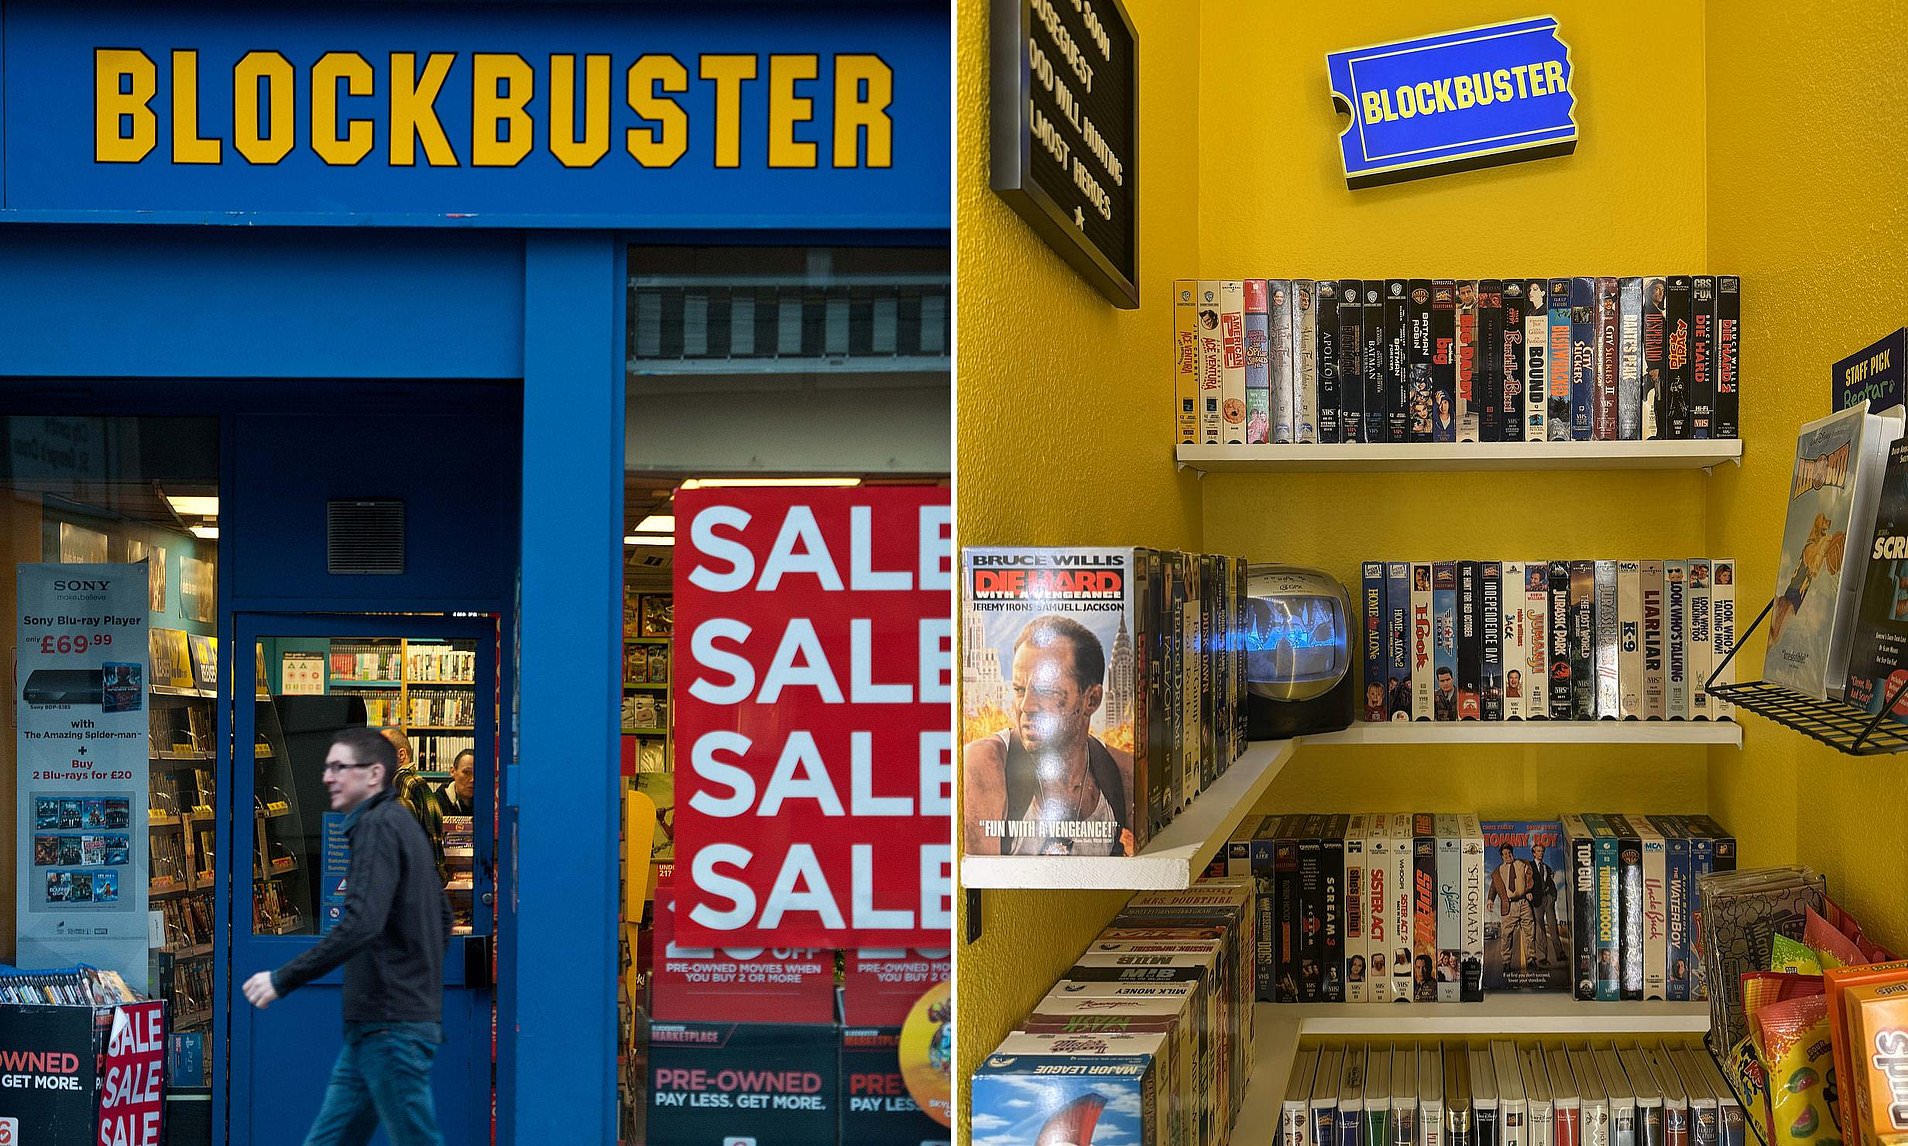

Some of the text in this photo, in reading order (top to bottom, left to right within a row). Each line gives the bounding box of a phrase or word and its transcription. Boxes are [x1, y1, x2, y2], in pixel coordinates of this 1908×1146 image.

[93, 47, 893, 169] BLOCKBUSTER
[1361, 60, 1566, 125] BLOCKBUSTER
[1055, 75, 1082, 134] WILL
[1083, 116, 1123, 187] HUNTING
[1693, 278, 1712, 289] CBS
[1693, 289, 1712, 299] FOX
[1180, 331, 1193, 374] ACE VENTURA
[1223, 314, 1235, 368] PIE
[1232, 315, 1243, 366] AMERICAN
[1411, 319, 1420, 349] ROBIN
[1432, 337, 1453, 366] big
[1623, 314, 1638, 380] DANTE'S PEAK
[1645, 313, 1664, 363] DESPERADO
[1695, 314, 1705, 383] DIE HARD
[1202, 337, 1217, 390] ACE VENTURA
[1323, 331, 1333, 392] APOLLO 13
[1460, 314, 1474, 402] BIG DADDY
[1529, 346, 1544, 403] BOUND
[1551, 325, 1569, 397] BUSHWHACKED
[1573, 340, 1584, 384] SLICKERS
[1582, 346, 1593, 370] CITY
[1605, 325, 1615, 395] CITY SLICKERS II
[1722, 319, 1732, 393] DIE HARD 2
[1846, 348, 1890, 387] STAFF PICK
[688, 506, 951, 592] SALE
[973, 555, 1124, 566] BRUCE WILLIS
[1873, 536, 1908, 560] SCR
[54, 580, 111, 591] SONY
[975, 570, 1122, 593] DIE HARD
[976, 591, 1121, 599] WITH A VENGEANCE
[1463, 566, 1473, 637] THE HUNT FOR RED OCTOBER
[23, 615, 141, 627] Sony Blu-ray Player
[973, 603, 1005, 612] JEREMY
[1006, 603, 1033, 612] IRONS
[1083, 603, 1125, 612] JACKSON
[1484, 582, 1498, 664] INDEPENDENCE DAY
[1504, 614, 1516, 640] JACK
[1553, 589, 1567, 656] JURASSIC PARK
[1579, 594, 1590, 659] THE LOST WORLD
[1691, 597, 1700, 642] TALKING TOO
[1700, 597, 1709, 642] LOOK WHO'S
[1714, 600, 1723, 632] TALKING
[1724, 600, 1733, 623] LOOK
[25, 634, 113, 654] only £69.99
[1415, 602, 1430, 672] Hook
[1527, 609, 1545, 674] JUMANJI
[1623, 621, 1636, 653] K-9
[1670, 581, 1683, 683] LOOK WHO'S TALKING
[688, 618, 951, 705] SALE
[24, 731, 41, 739] The
[43, 731, 83, 740] Amazing
[71, 719, 94, 728] with
[33, 771, 132, 781] 2 Blu-rays for £20
[72, 759, 93, 769] Buy
[688, 731, 951, 818] SALE
[1008, 820, 1036, 837] WITH
[1483, 832, 1559, 848] TOMMY BOY
[688, 843, 951, 931] SALE
[1577, 843, 1592, 892] TOP GUN
[1325, 877, 1335, 947] SCREAM 3
[1371, 868, 1384, 943] SISTER ACT
[1415, 869, 1434, 943] SPEED
[1466, 864, 1478, 946] STIGMATA
[1670, 879, 1682, 950] WATERBOY
[666, 963, 822, 974] PRE-OWNED MOVIES WHEN
[1257, 942, 1272, 964] DOGS
[687, 973, 803, 984] YOU BUY 2 OR MORE
[1115, 987, 1187, 995] MILK MONEY
[652, 1031, 719, 1043] MARKETPLACE
[0, 1051, 80, 1074] WNED
[2, 1075, 83, 1091] GET MORE.
[655, 1069, 823, 1094] PRE-OWNED
[1033, 1064, 1138, 1075] MAJOR LEAGUE
[102, 1060, 162, 1109] SALE
[655, 1092, 827, 1111] PAY LESS. GET MORE.
[100, 1111, 160, 1146] SALE
